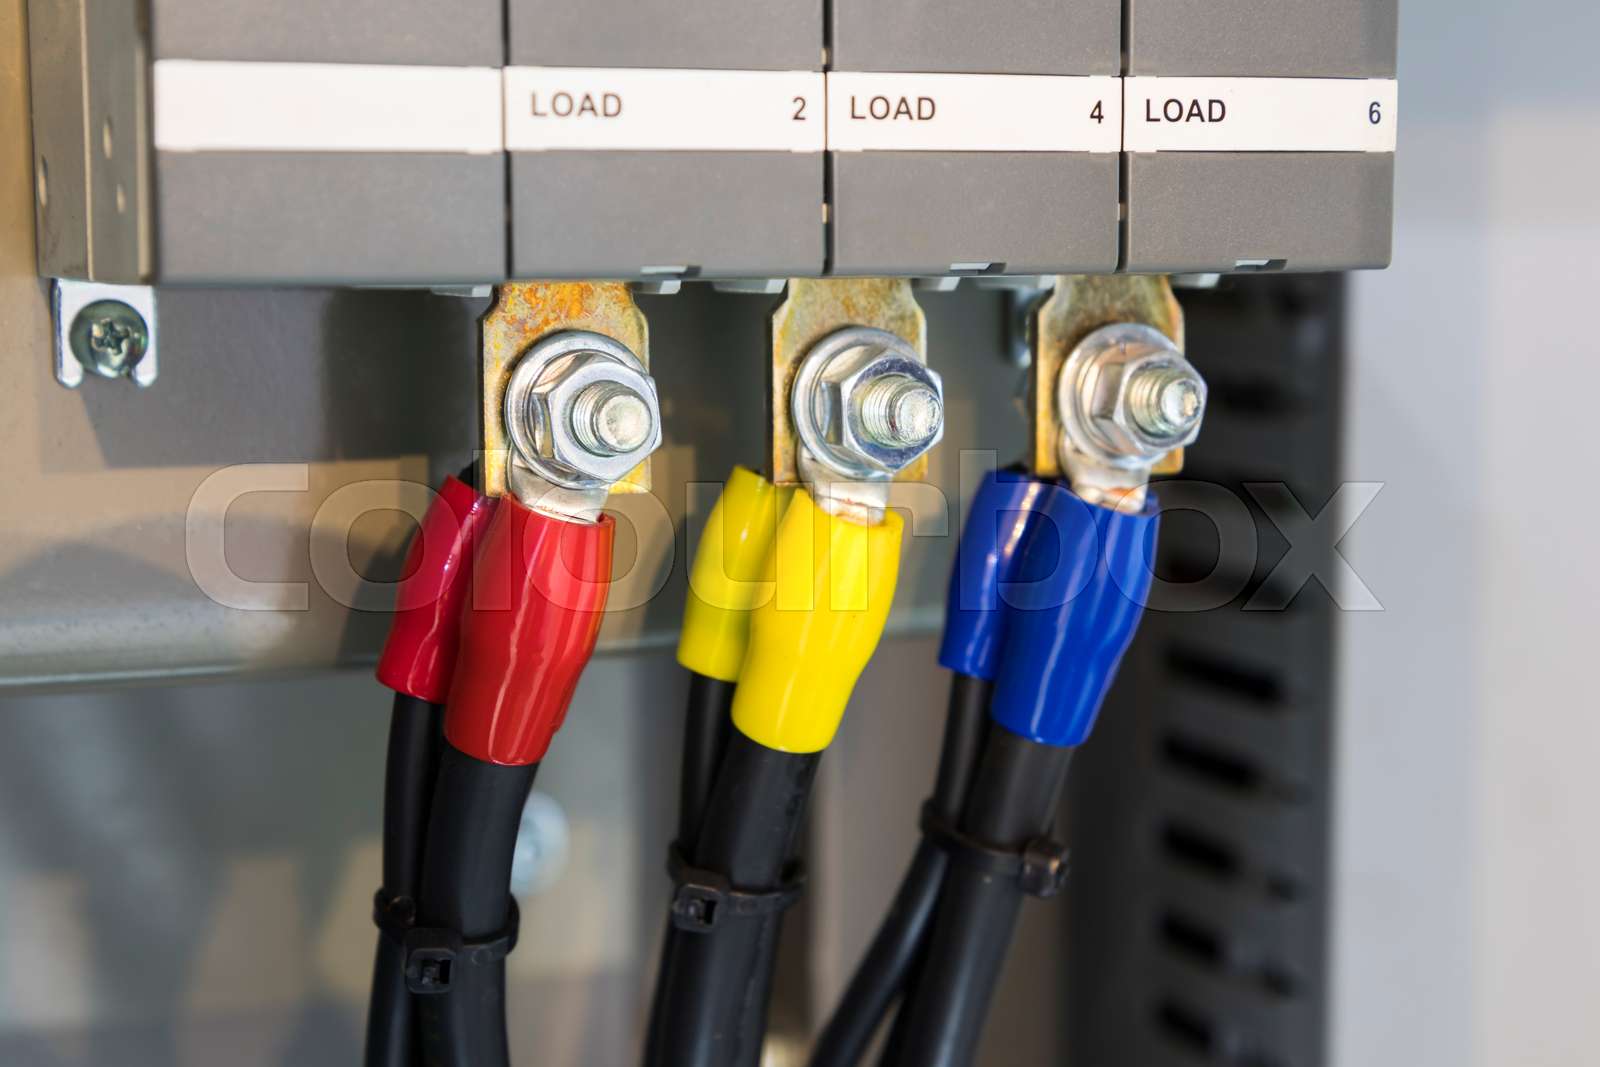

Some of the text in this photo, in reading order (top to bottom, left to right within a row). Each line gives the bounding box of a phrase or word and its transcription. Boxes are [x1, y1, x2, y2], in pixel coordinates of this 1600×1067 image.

[531, 91, 806, 122] LOAD 2
[849, 95, 1105, 125] LOAD 4
[1144, 98, 1382, 125] LOAD 6
